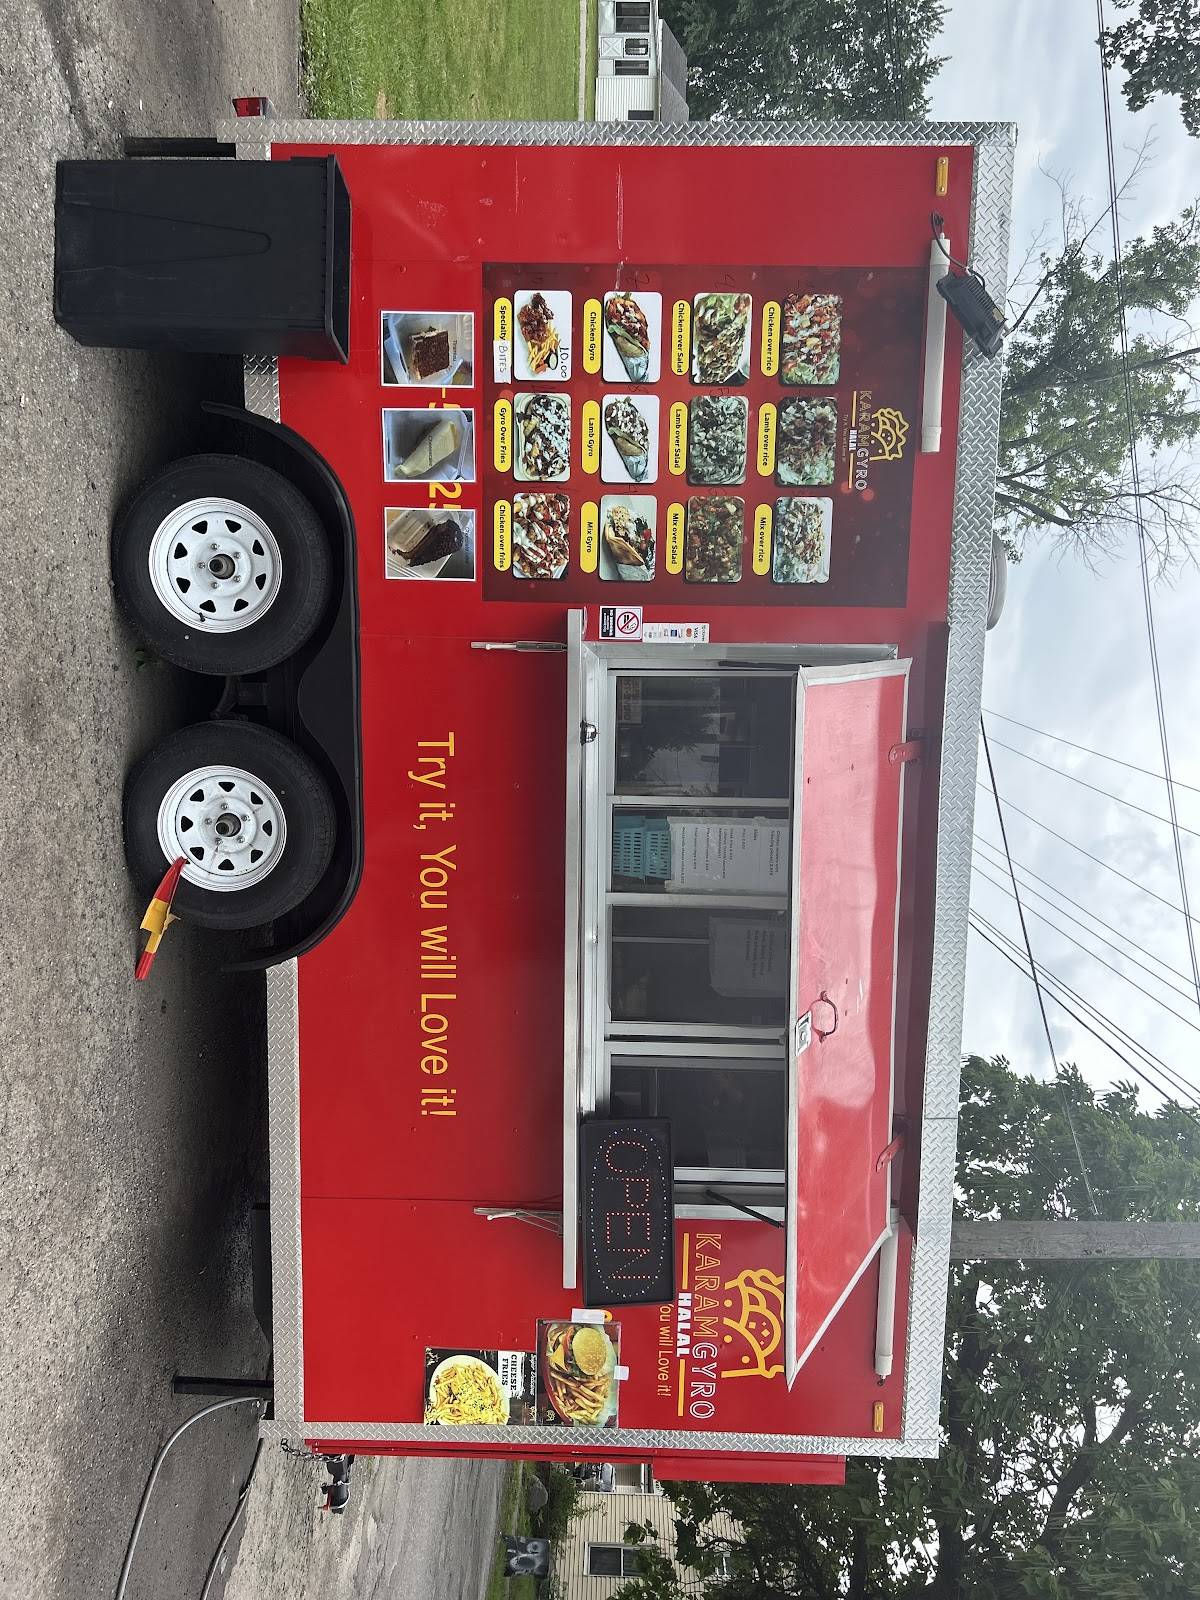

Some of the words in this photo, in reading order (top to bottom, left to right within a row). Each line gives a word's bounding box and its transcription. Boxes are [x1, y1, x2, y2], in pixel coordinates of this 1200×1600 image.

[499, 305, 507, 341] Specialty
[589, 311, 597, 342] Chicken
[677, 302, 685, 333] Chicken
[767, 306, 775, 337] Chicken
[498, 345, 508, 373] BITES
[588, 343, 596, 361] Gyro
[766, 356, 774, 371] rice
[499, 407, 507, 426] Gyro
[675, 408, 683, 429] Lamb
[587, 439, 595, 457] Gyro
[848, 429, 857, 451] HALAL
[855, 390, 872, 490] KARAMGYRO
[762, 452, 770, 466] rice
[586, 521, 594, 535] Mix
[759, 516, 767, 530] Mix
[585, 536, 593, 553] Gyro
[408, 731, 455, 789] Try
[413, 802, 456, 831] it,
[419, 844, 457, 909] You
[420, 925, 457, 979] will
[419, 993, 457, 1075] Love
[420, 1088, 457, 1117] it!
[604, 1140, 651, 1280] OPEN
[658, 1326, 674, 1346] will
[676, 1292, 692, 1358] HALAL
[689, 1232, 721, 1419] KARAMGYRO
[501, 1358, 509, 1386] FRIES
[510, 1354, 518, 1391] CHEESE
[657, 1350, 673, 1381] Love
[657, 1385, 671, 1397] it!
